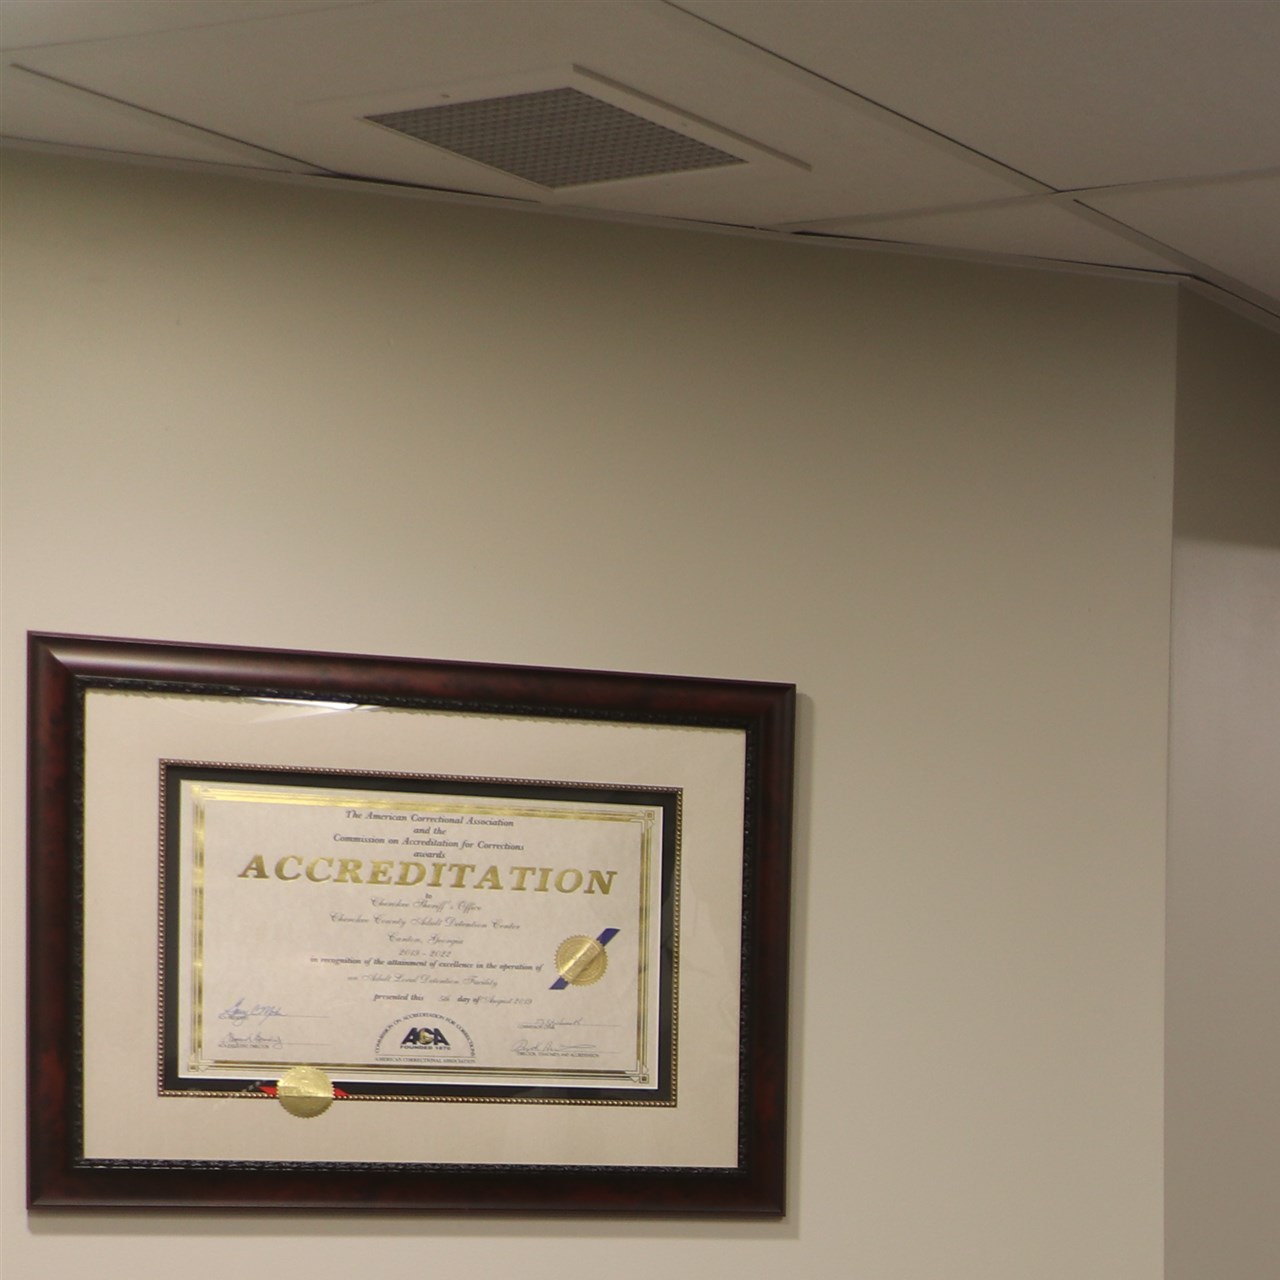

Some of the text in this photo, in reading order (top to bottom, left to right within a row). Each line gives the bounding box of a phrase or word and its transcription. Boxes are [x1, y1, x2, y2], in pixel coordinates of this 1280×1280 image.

[345, 810, 514, 827] The American Correctional Association
[413, 826, 447, 836] and the
[333, 833, 385, 845] Commission
[402, 837, 459, 849] Accreditation
[460, 839, 474, 851] for
[477, 840, 525, 851] Corrections
[413, 850, 446, 859] awards
[237, 854, 619, 895] ACCREDITATION
[320, 957, 361, 966] recognition
[373, 957, 385, 966] the
[387, 958, 427, 967] attainment
[429, 959, 438, 970] of
[438, 960, 474, 969] excellence
[486, 962, 497, 970] the
[499, 962, 533, 972] operation
[535, 962, 545, 973] of
[373, 993, 408, 1002] presented
[410, 993, 424, 1002] this
[456, 995, 471, 1005] day
[401, 1027, 450, 1046] ACA
